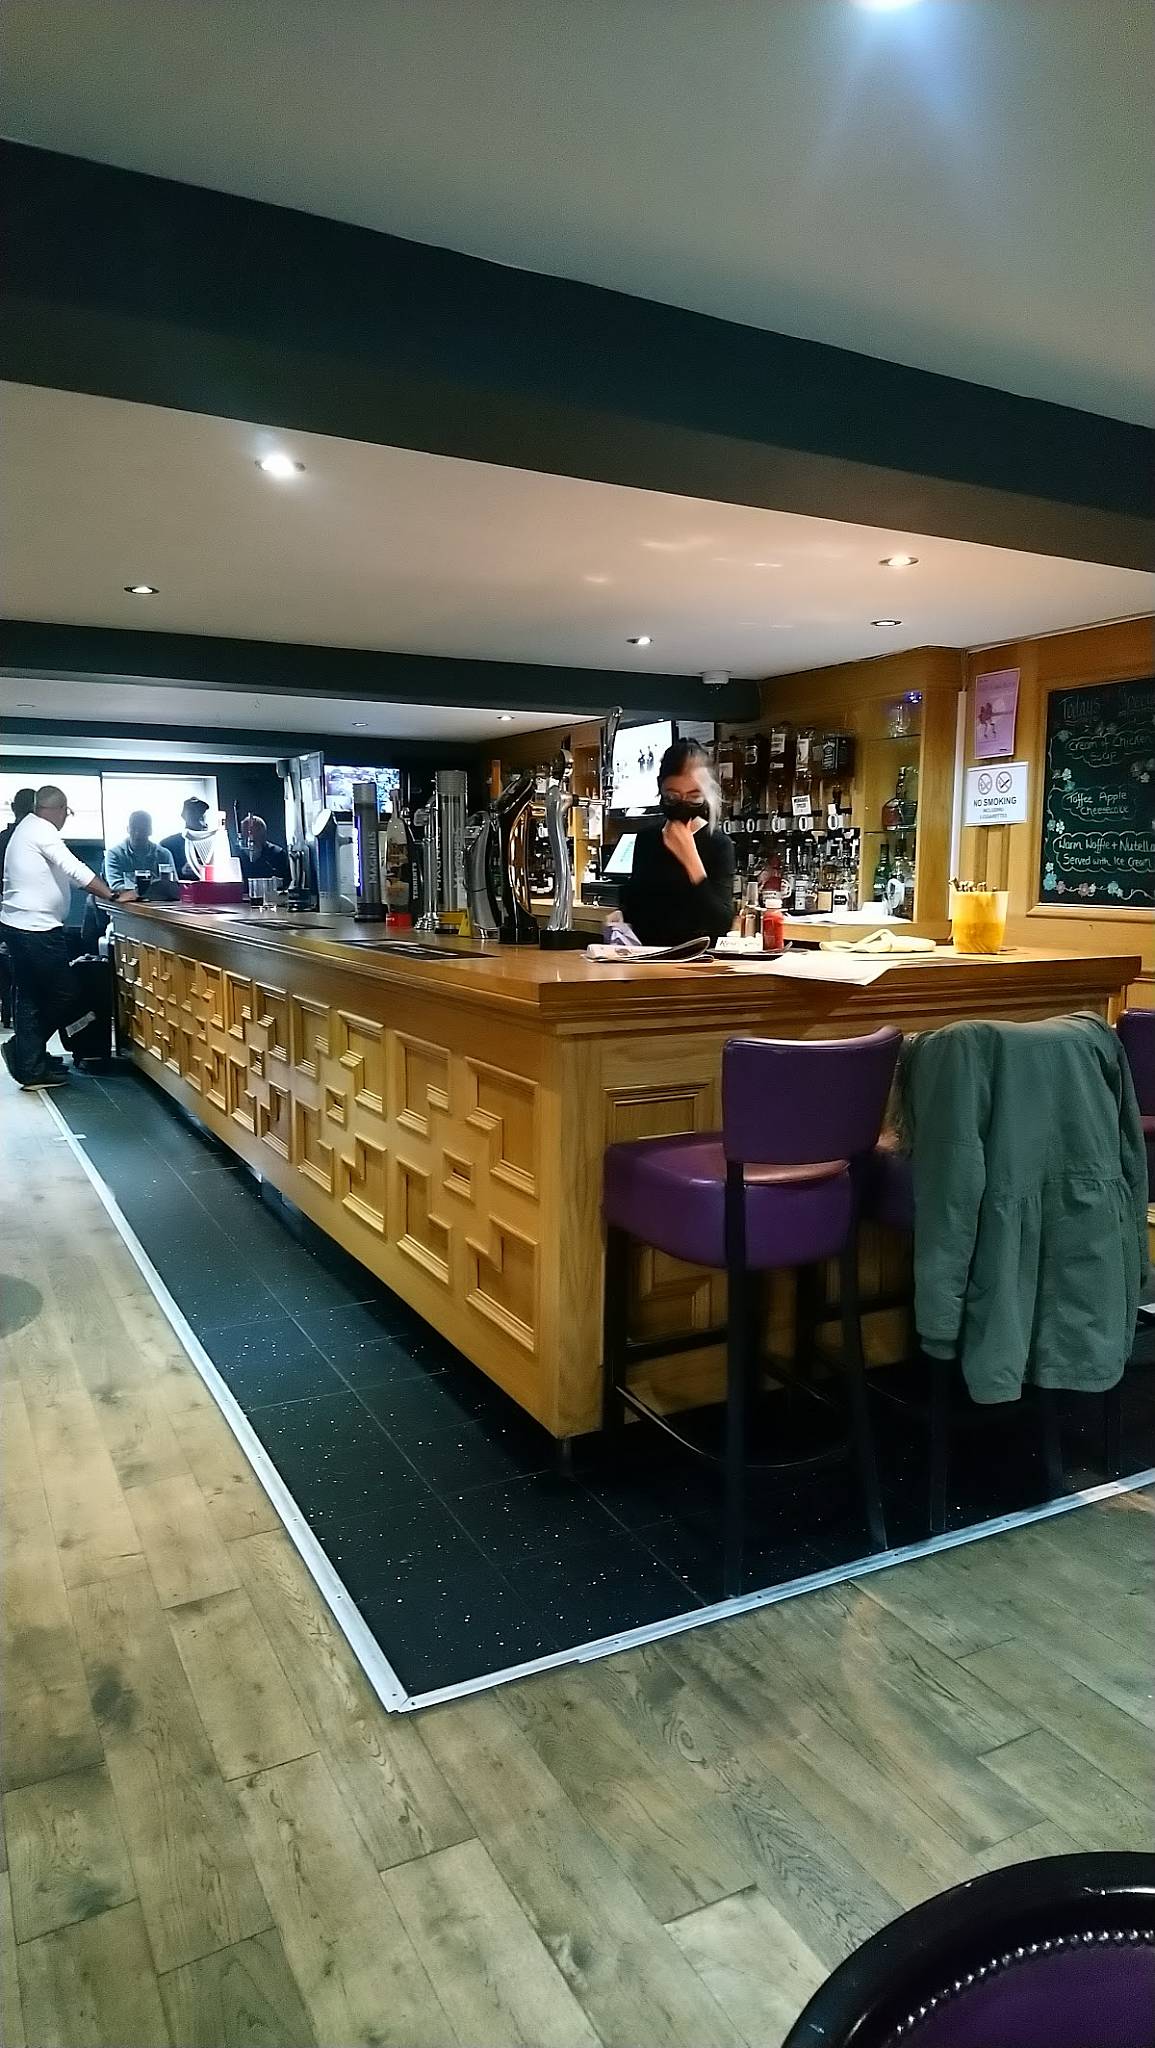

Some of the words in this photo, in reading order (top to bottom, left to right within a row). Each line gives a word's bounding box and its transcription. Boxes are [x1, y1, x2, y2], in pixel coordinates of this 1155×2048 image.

[974, 799, 983, 807] NO
[983, 796, 1017, 806] SMOKING
[1067, 792, 1093, 809] Toffee
[1099, 792, 1127, 806] Apple
[1059, 838, 1083, 850] Warm
[1086, 838, 1110, 854] Waffle
[1120, 837, 1155, 852] Nutella
[1063, 853, 1091, 866] Served
[1092, 856, 1112, 866] with
[1113, 856, 1125, 866] Ice
[1128, 857, 1152, 868] Cream
